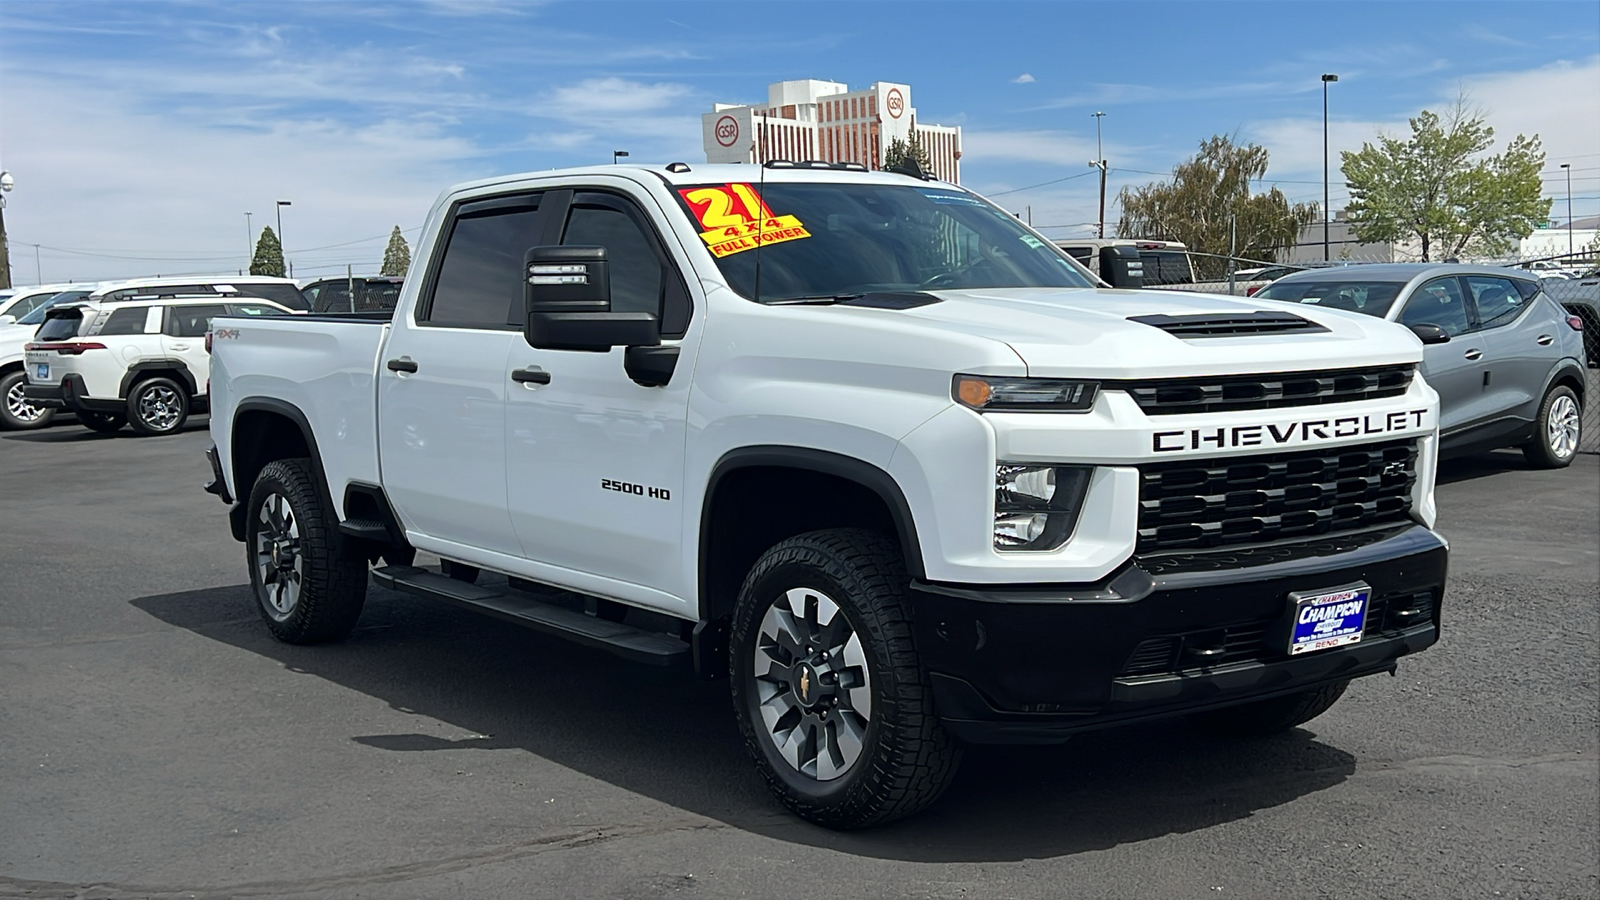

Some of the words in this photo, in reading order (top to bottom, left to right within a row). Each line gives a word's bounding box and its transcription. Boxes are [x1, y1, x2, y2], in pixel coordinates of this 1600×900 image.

[890, 97, 902, 110] GSR
[718, 124, 735, 138] GSR
[686, 183, 769, 228] 21
[712, 239, 752, 255] FULL
[752, 227, 805, 245] POWER
[1153, 408, 1428, 452] CHEVROLET
[601, 478, 644, 496] 2500
[648, 486, 671, 501] HD
[1317, 593, 1352, 605] CHAMPION
[1299, 600, 1363, 625] CHAMPION
[1315, 639, 1338, 648] RENO
